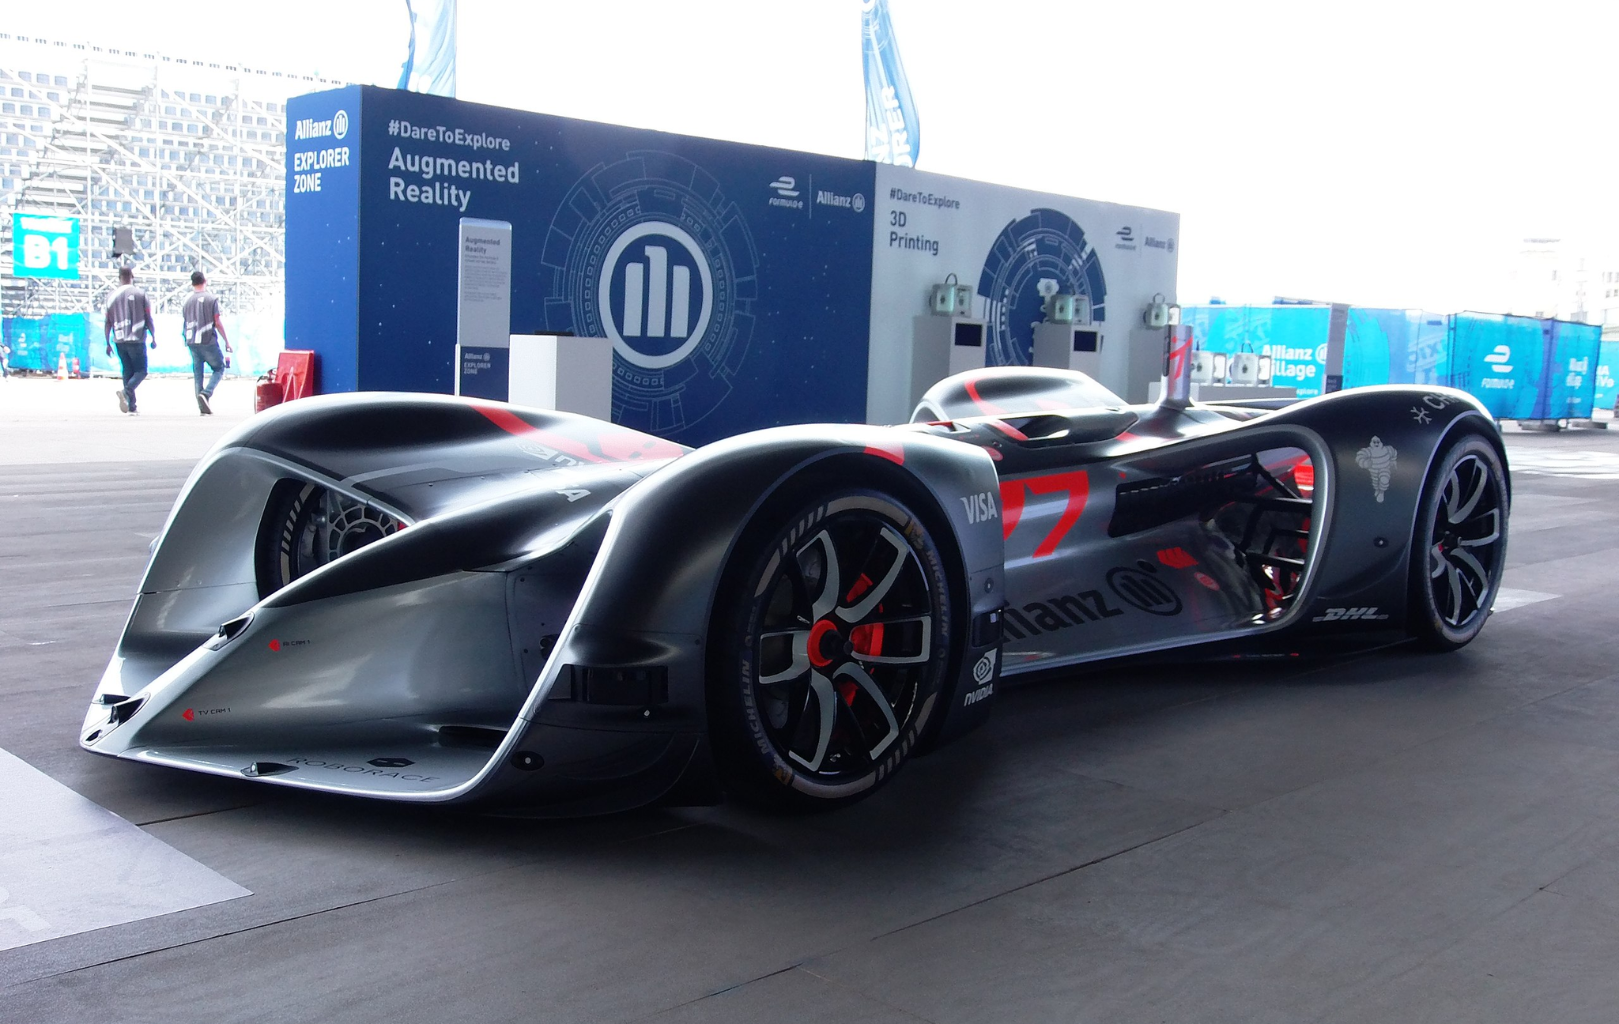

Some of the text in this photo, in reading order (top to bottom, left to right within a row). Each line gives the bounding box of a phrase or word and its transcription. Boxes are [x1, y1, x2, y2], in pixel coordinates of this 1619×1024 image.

[294, 118, 332, 141] Allianz
[388, 119, 511, 151] #DareToExplore
[294, 147, 350, 171] EXPLORER
[388, 147, 520, 184] Augmented
[293, 173, 321, 194] ZONE
[389, 177, 471, 212] Reality
[816, 190, 851, 208] Allianz
[889, 187, 961, 210] #DareToExplore
[889, 210, 907, 228] 3D
[24, 234, 68, 270] B1
[889, 231, 939, 256] Printing
[1261, 344, 1313, 361] Allianz
[960, 491, 998, 525] VISA
[1322, 607, 1382, 621] DHL
[742, 659, 769, 755] MICHELIN
[286, 756, 441, 783] ROBORACE
